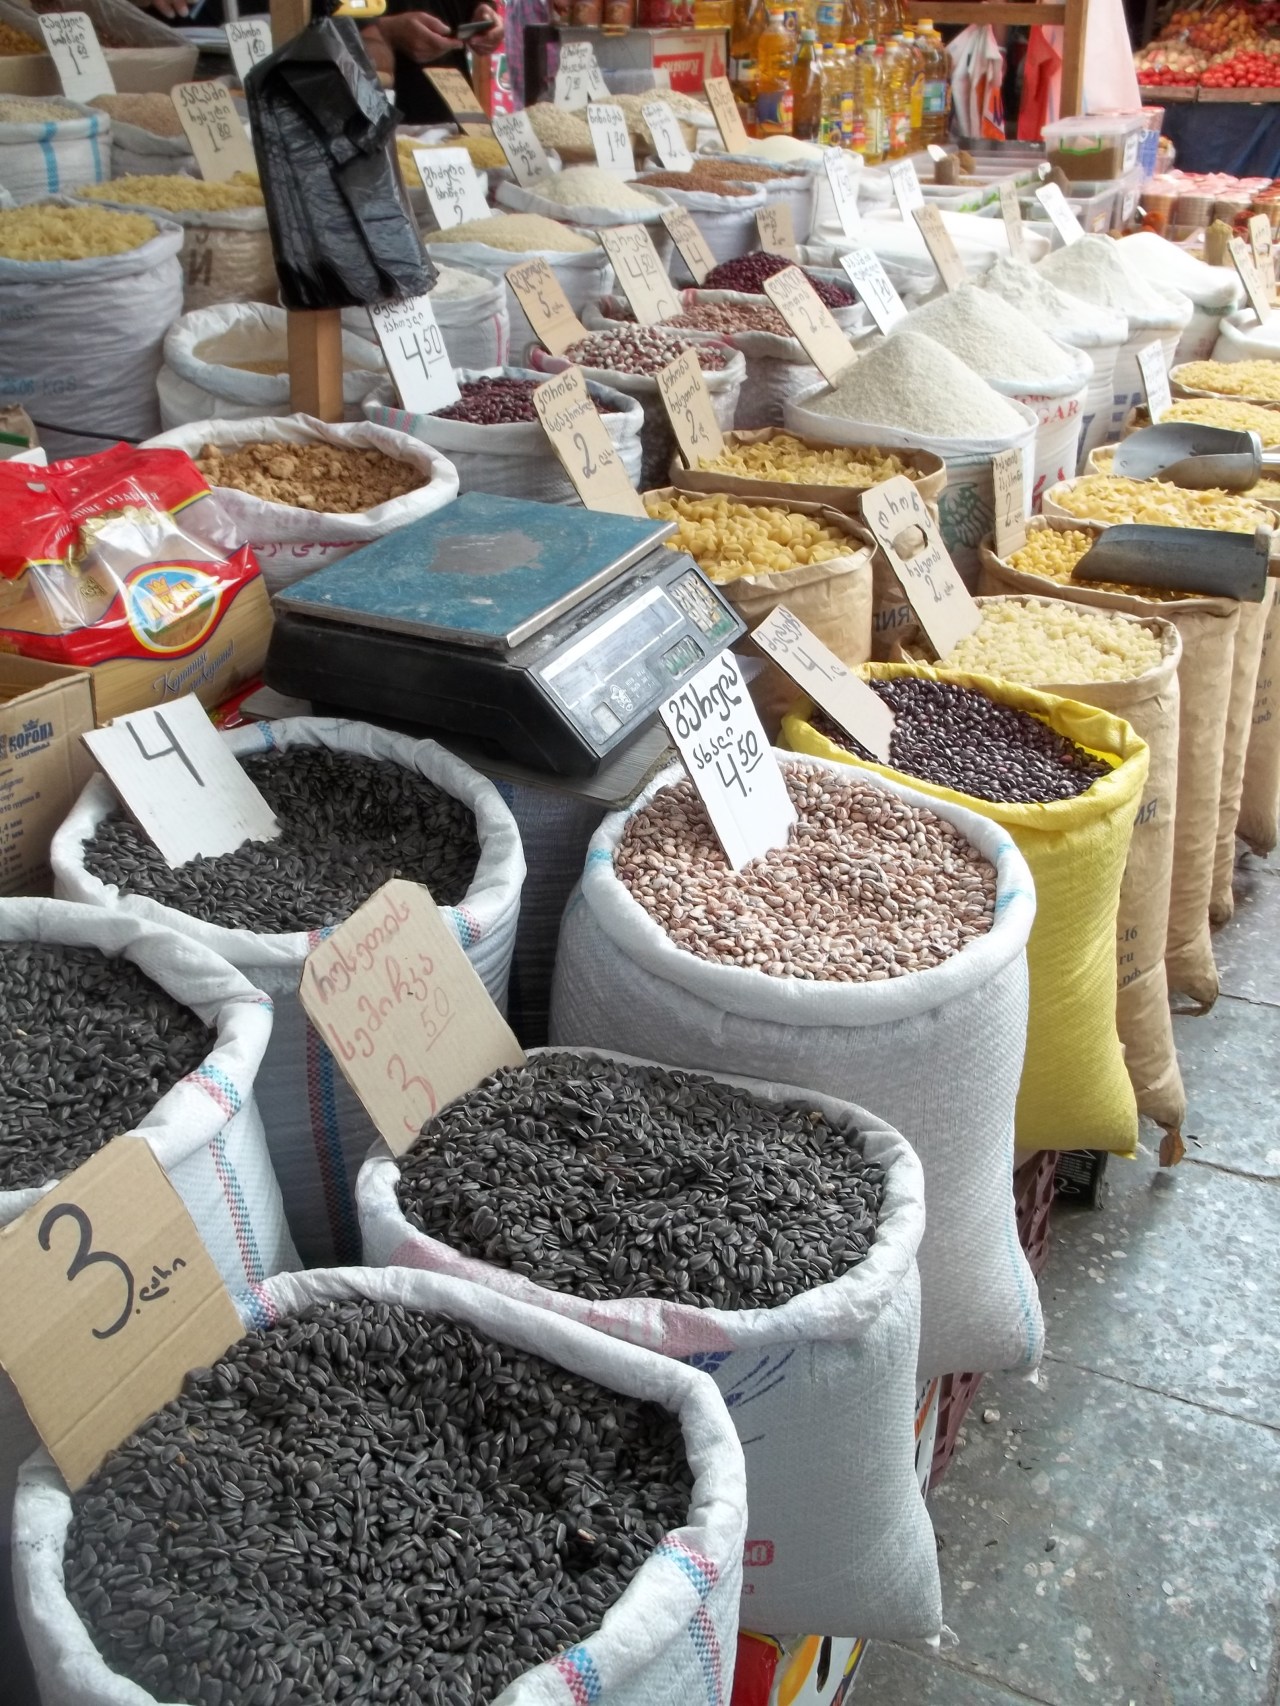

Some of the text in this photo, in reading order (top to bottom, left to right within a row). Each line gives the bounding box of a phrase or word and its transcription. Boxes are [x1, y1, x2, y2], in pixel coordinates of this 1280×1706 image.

[538, 375, 578, 415] კორონა
[125, 710, 205, 788] 4
[692, 726, 734, 770] ახალი
[309, 894, 411, 1005] რუსეთის
[327, 953, 434, 1062] სემიჩკა
